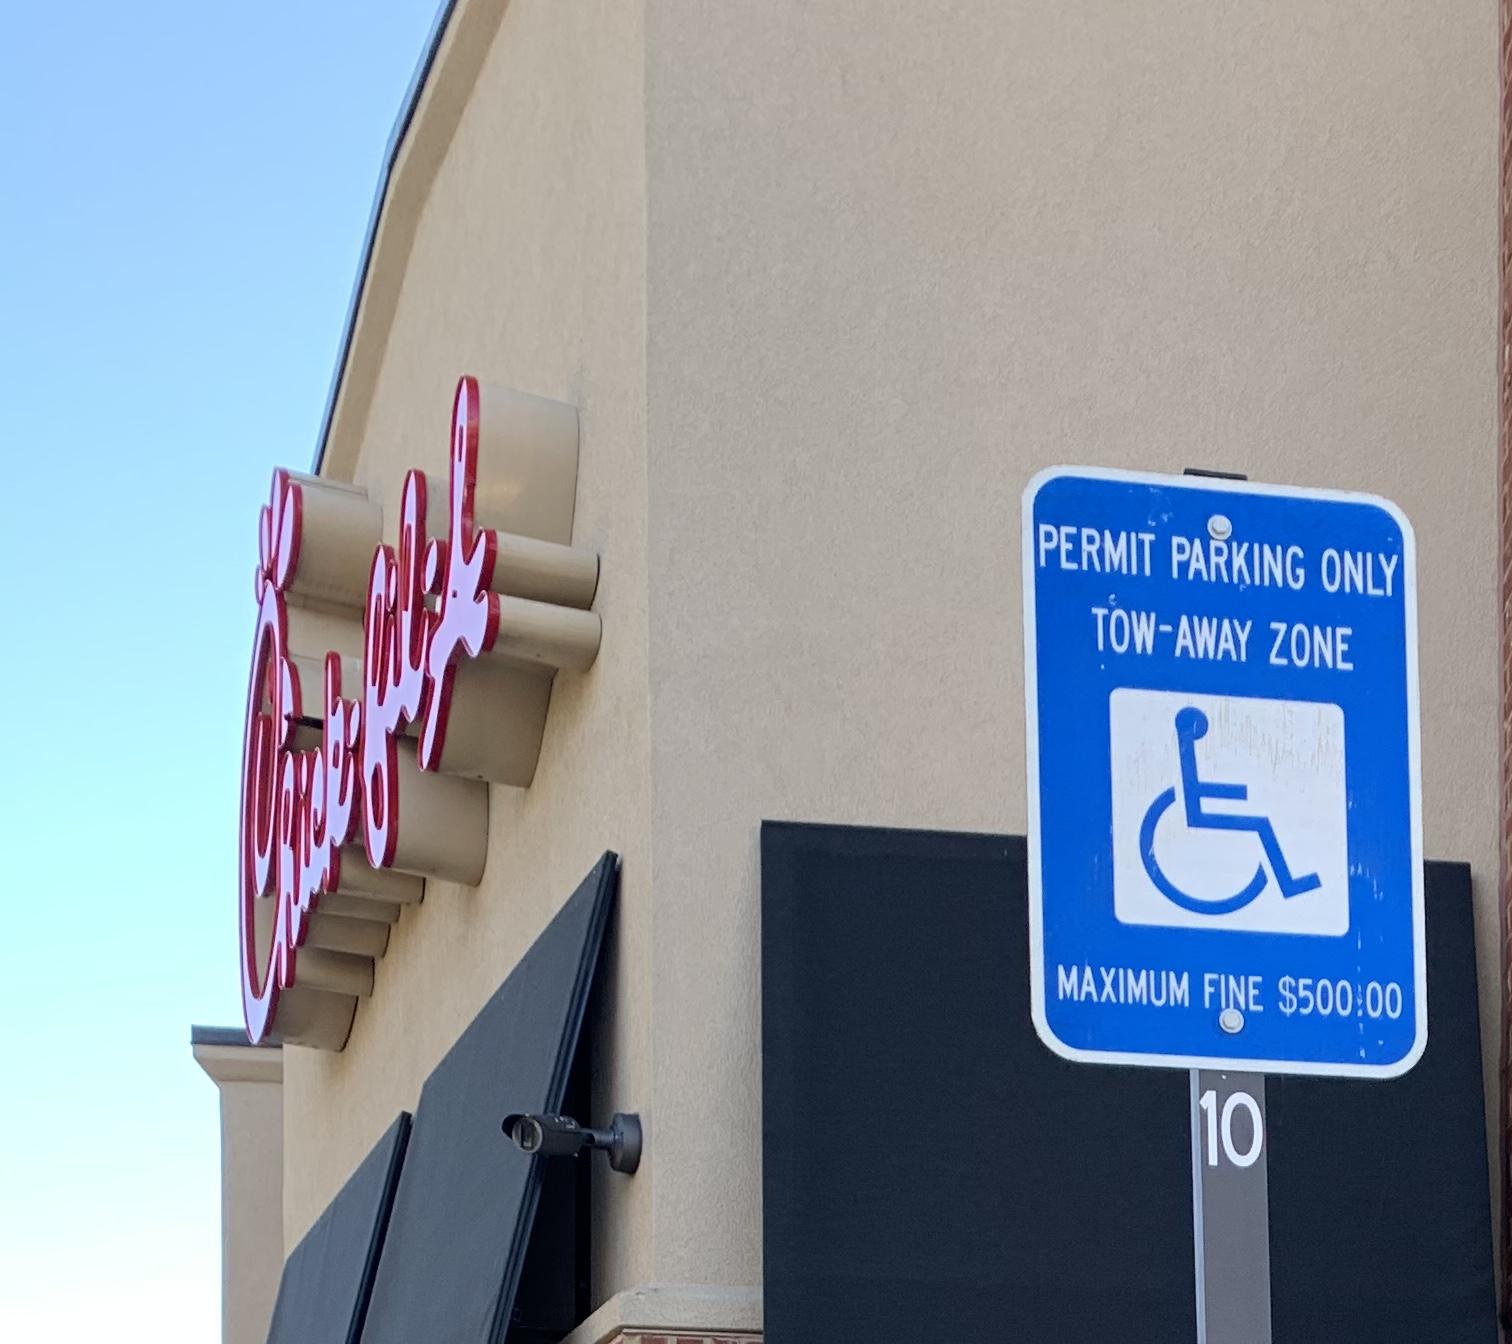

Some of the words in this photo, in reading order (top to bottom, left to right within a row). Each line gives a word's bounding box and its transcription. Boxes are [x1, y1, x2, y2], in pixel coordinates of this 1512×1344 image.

[1039, 522, 1155, 577] PERMIT
[1172, 536, 1305, 590] PARKING
[1321, 548, 1399, 598] ONLY
[1091, 607, 1253, 662] TOW-AWAY
[1270, 621, 1355, 671] ZONE
[1057, 964, 1189, 1008] MAXIMUM
[1204, 972, 1263, 1013] FINE
[1278, 975, 1403, 1019] $500.00
[1200, 1088, 1264, 1168] 10
